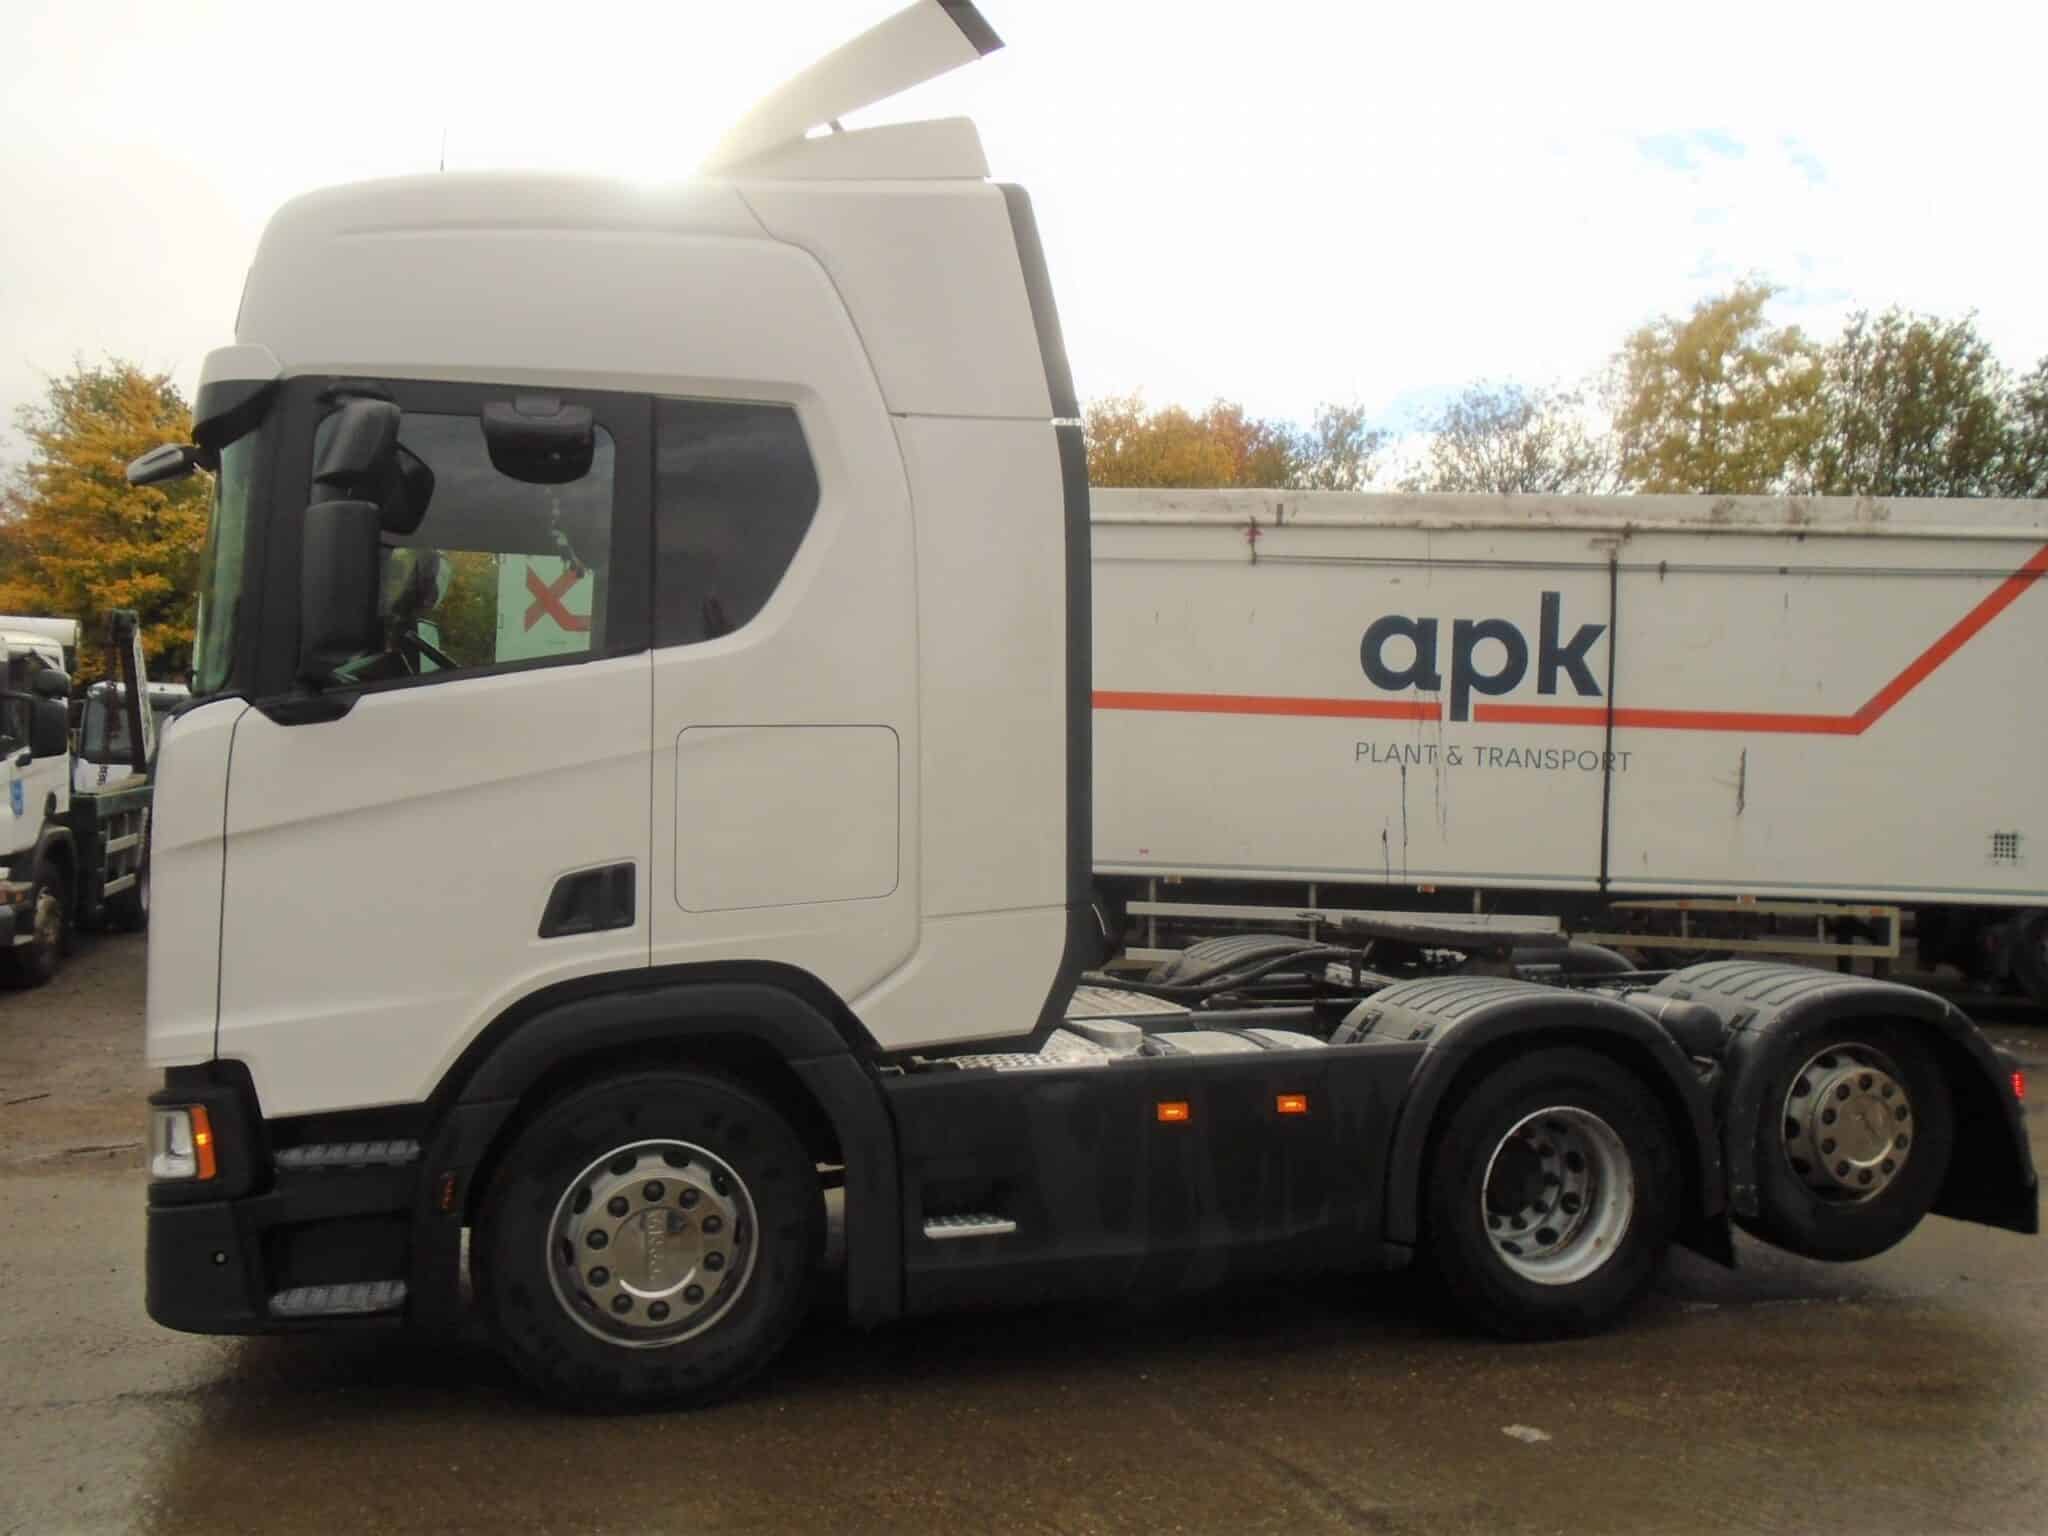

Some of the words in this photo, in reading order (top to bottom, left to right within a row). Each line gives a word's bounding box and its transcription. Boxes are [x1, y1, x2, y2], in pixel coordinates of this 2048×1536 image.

[1360, 591, 1607, 721] apk
[1355, 742, 1437, 765] PLANT
[1446, 745, 1463, 766] &
[1473, 746, 1632, 772] TRANSPORT
